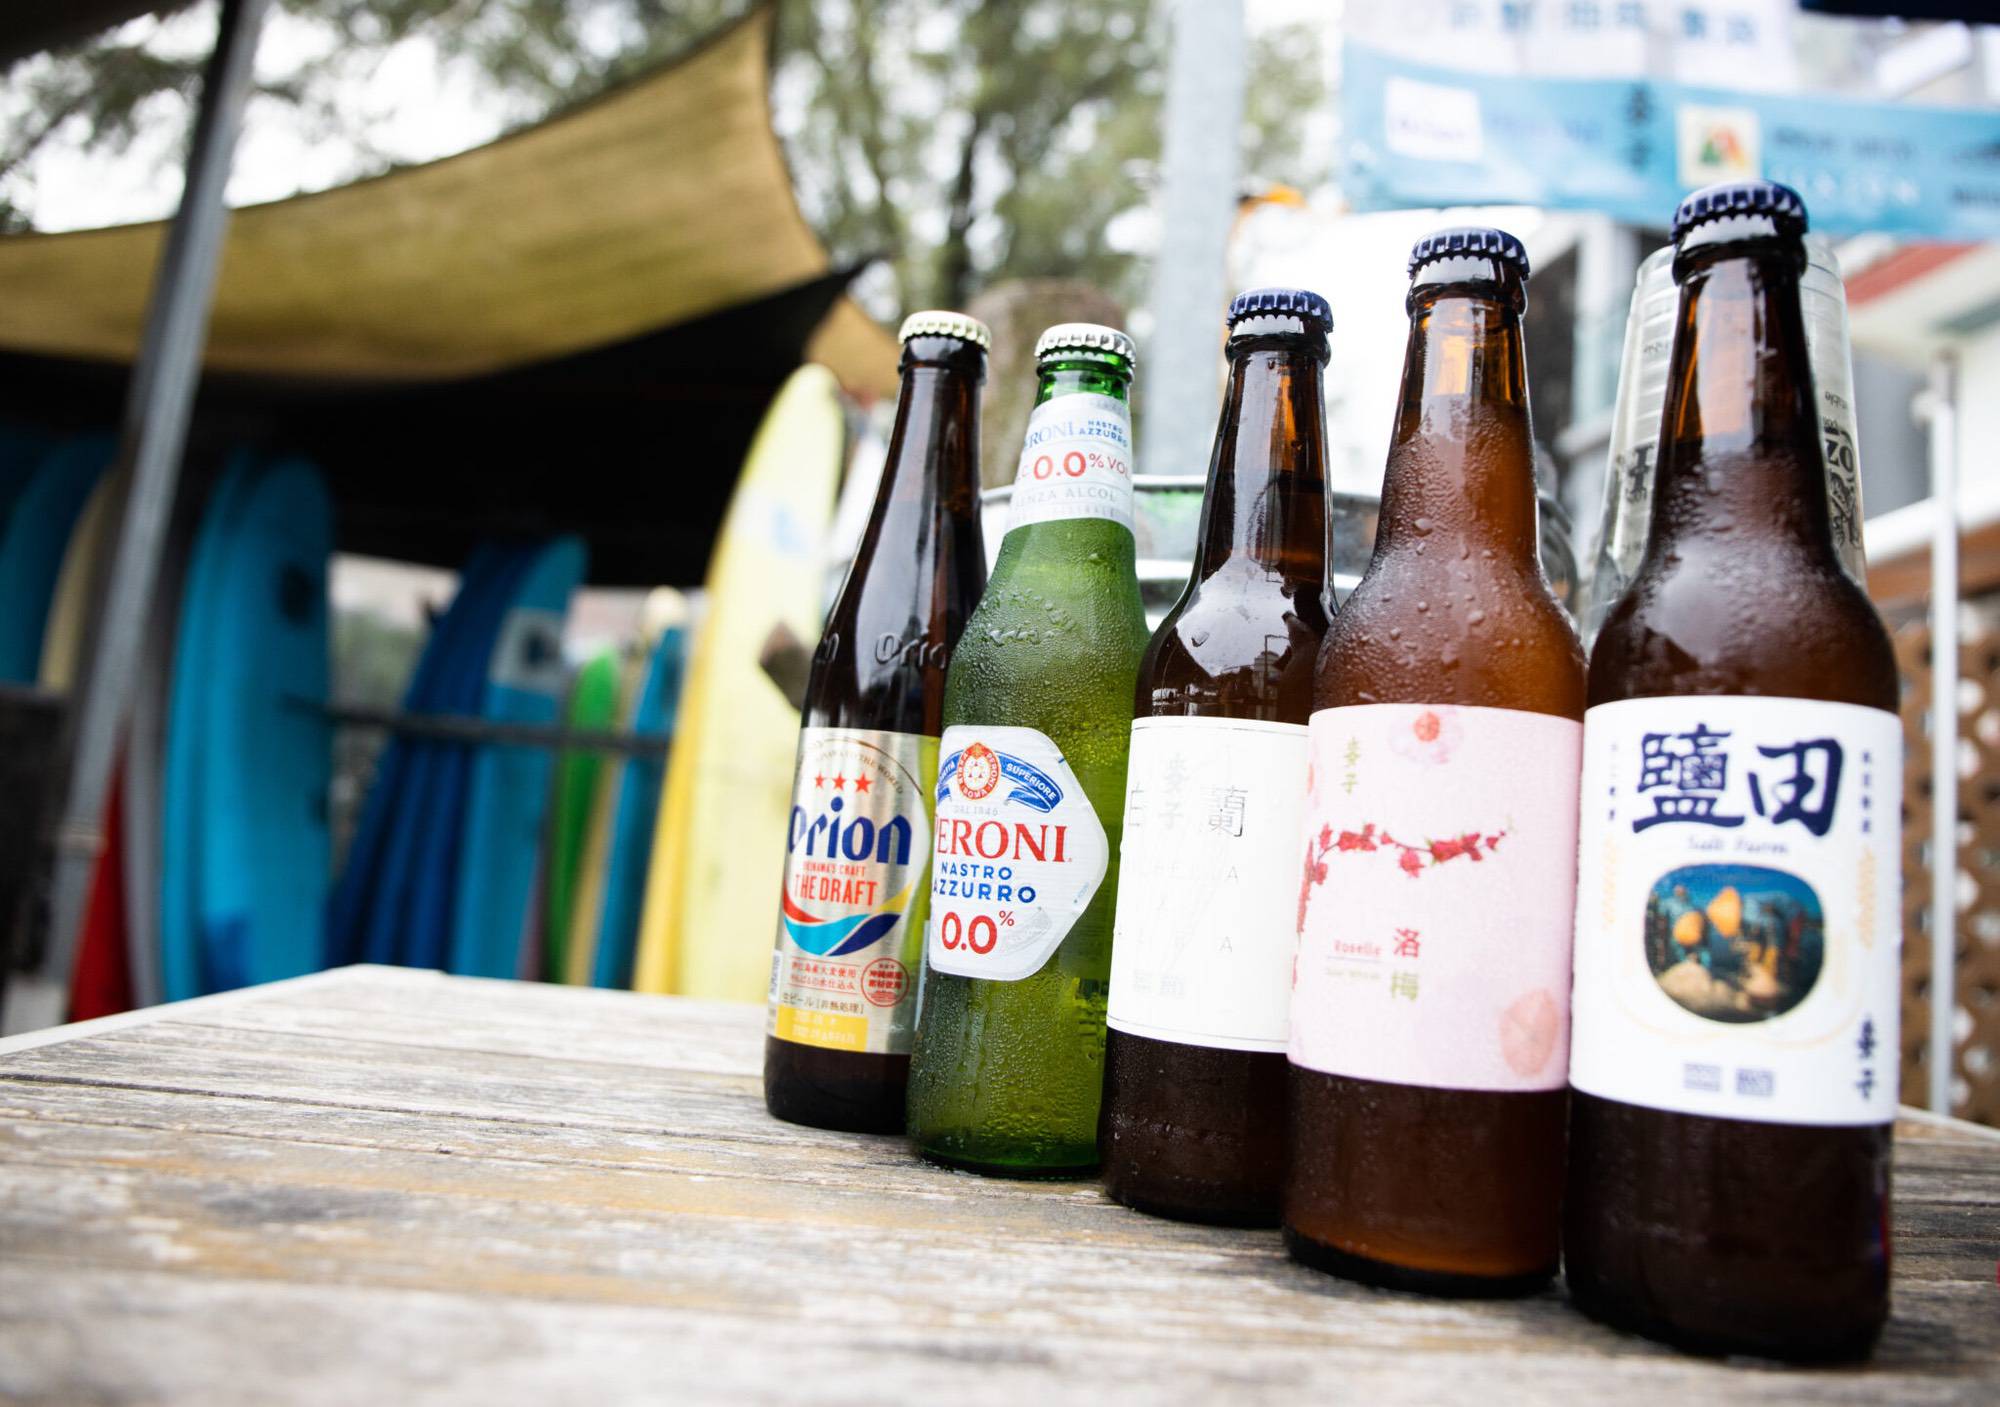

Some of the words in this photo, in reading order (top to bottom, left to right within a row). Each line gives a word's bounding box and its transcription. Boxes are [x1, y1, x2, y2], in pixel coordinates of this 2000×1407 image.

[1033, 450, 1104, 480] 0.0%
[1006, 763, 1056, 801] SUPERIORE
[1633, 723, 1845, 837] 鹽田
[934, 818, 1068, 862] ERONI
[941, 862, 1012, 880] NASTRO
[820, 878, 877, 906] DRAFT
[941, 910, 1015, 956] 0.0%
